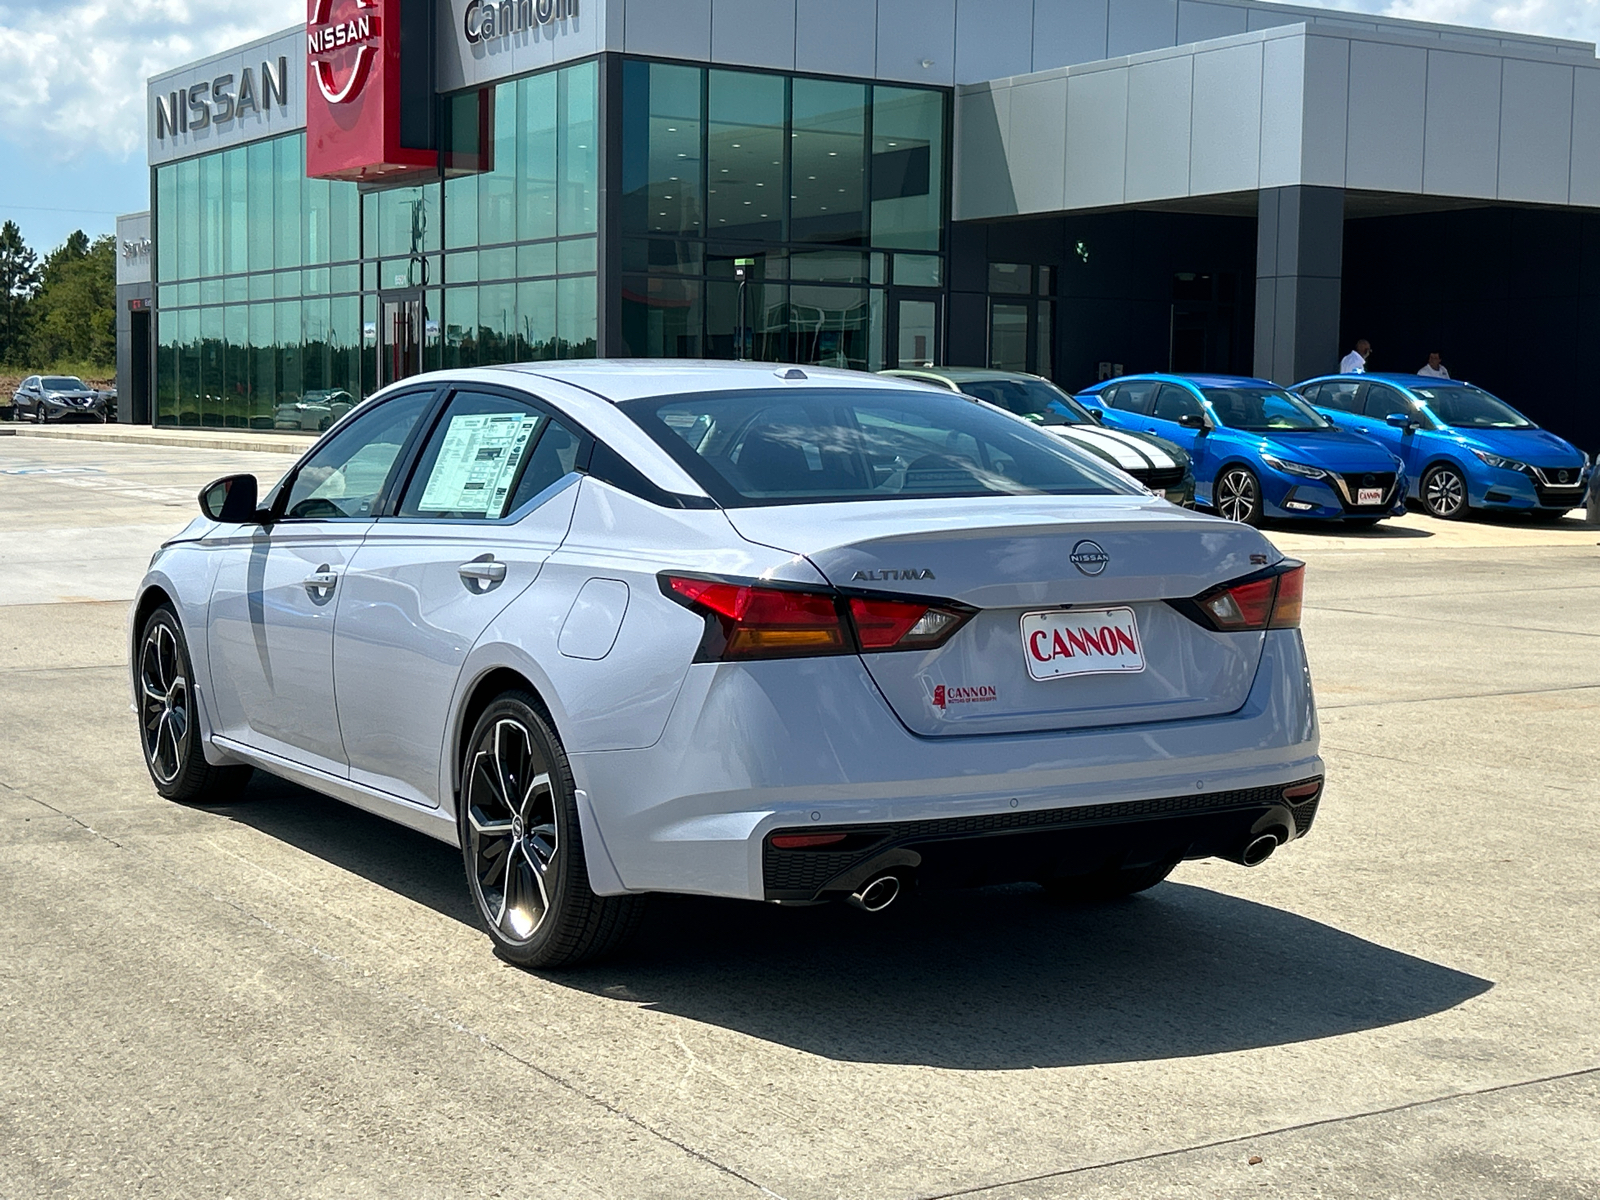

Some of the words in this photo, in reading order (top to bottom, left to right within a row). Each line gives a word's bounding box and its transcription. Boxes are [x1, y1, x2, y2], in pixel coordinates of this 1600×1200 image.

[308, 14, 370, 54] NISSAN
[156, 56, 287, 139] NISSAN
[1070, 554, 1109, 562] NISSAN
[1250, 554, 1268, 565] SR
[851, 568, 936, 581] ALTIMA
[1029, 625, 1137, 662] CANNON
[947, 686, 996, 698] CANNON
